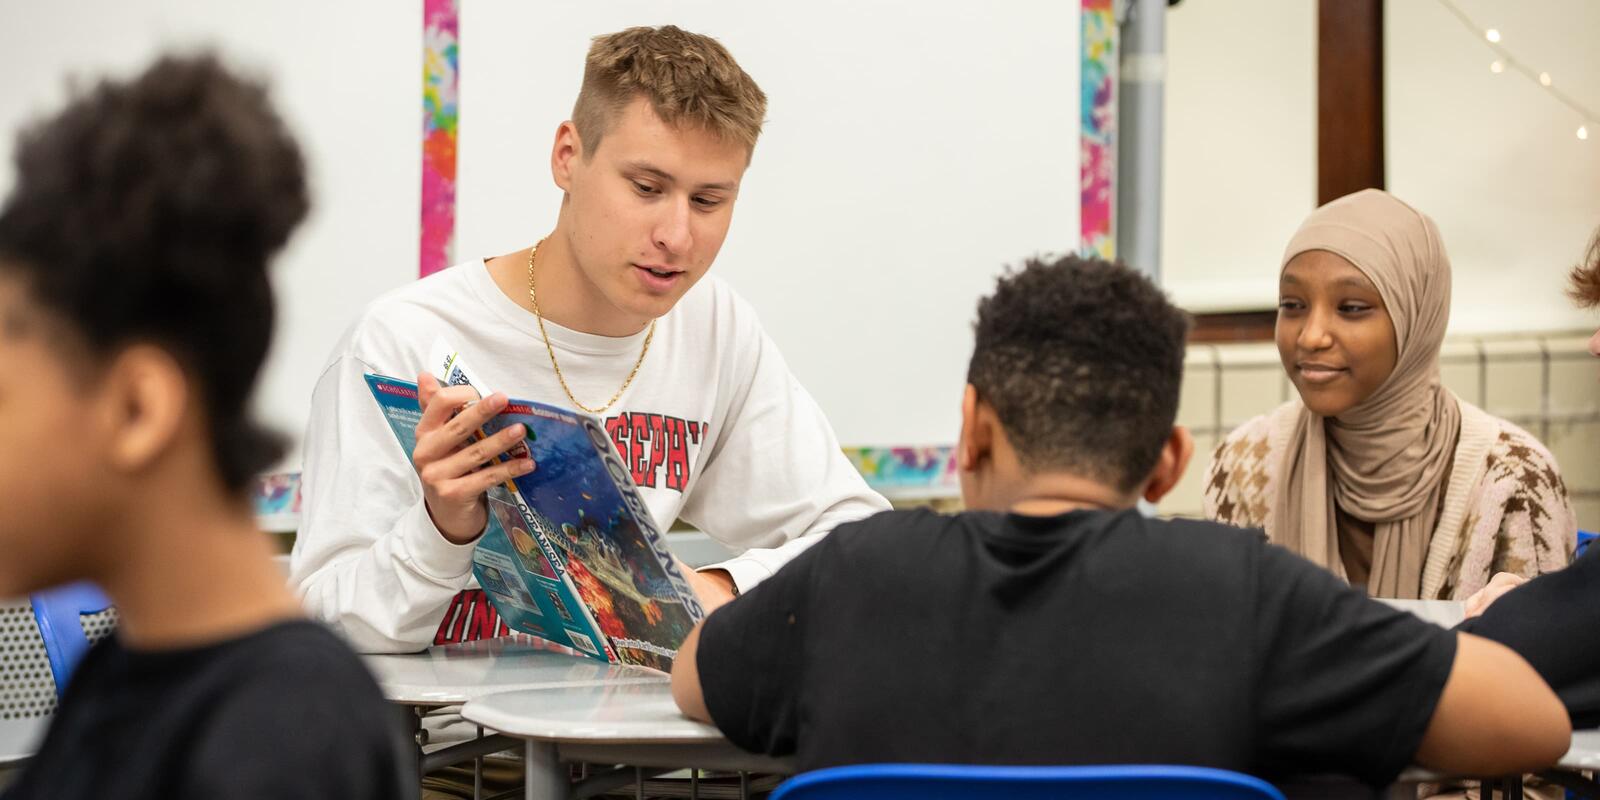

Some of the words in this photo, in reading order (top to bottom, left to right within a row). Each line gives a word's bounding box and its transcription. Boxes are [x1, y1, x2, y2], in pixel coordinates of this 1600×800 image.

[604, 412, 708, 493] SEPH'
[518, 503, 549, 549] OCEAN
[550, 551, 565, 576] SEA
[584, 421, 685, 583] OCEAN
